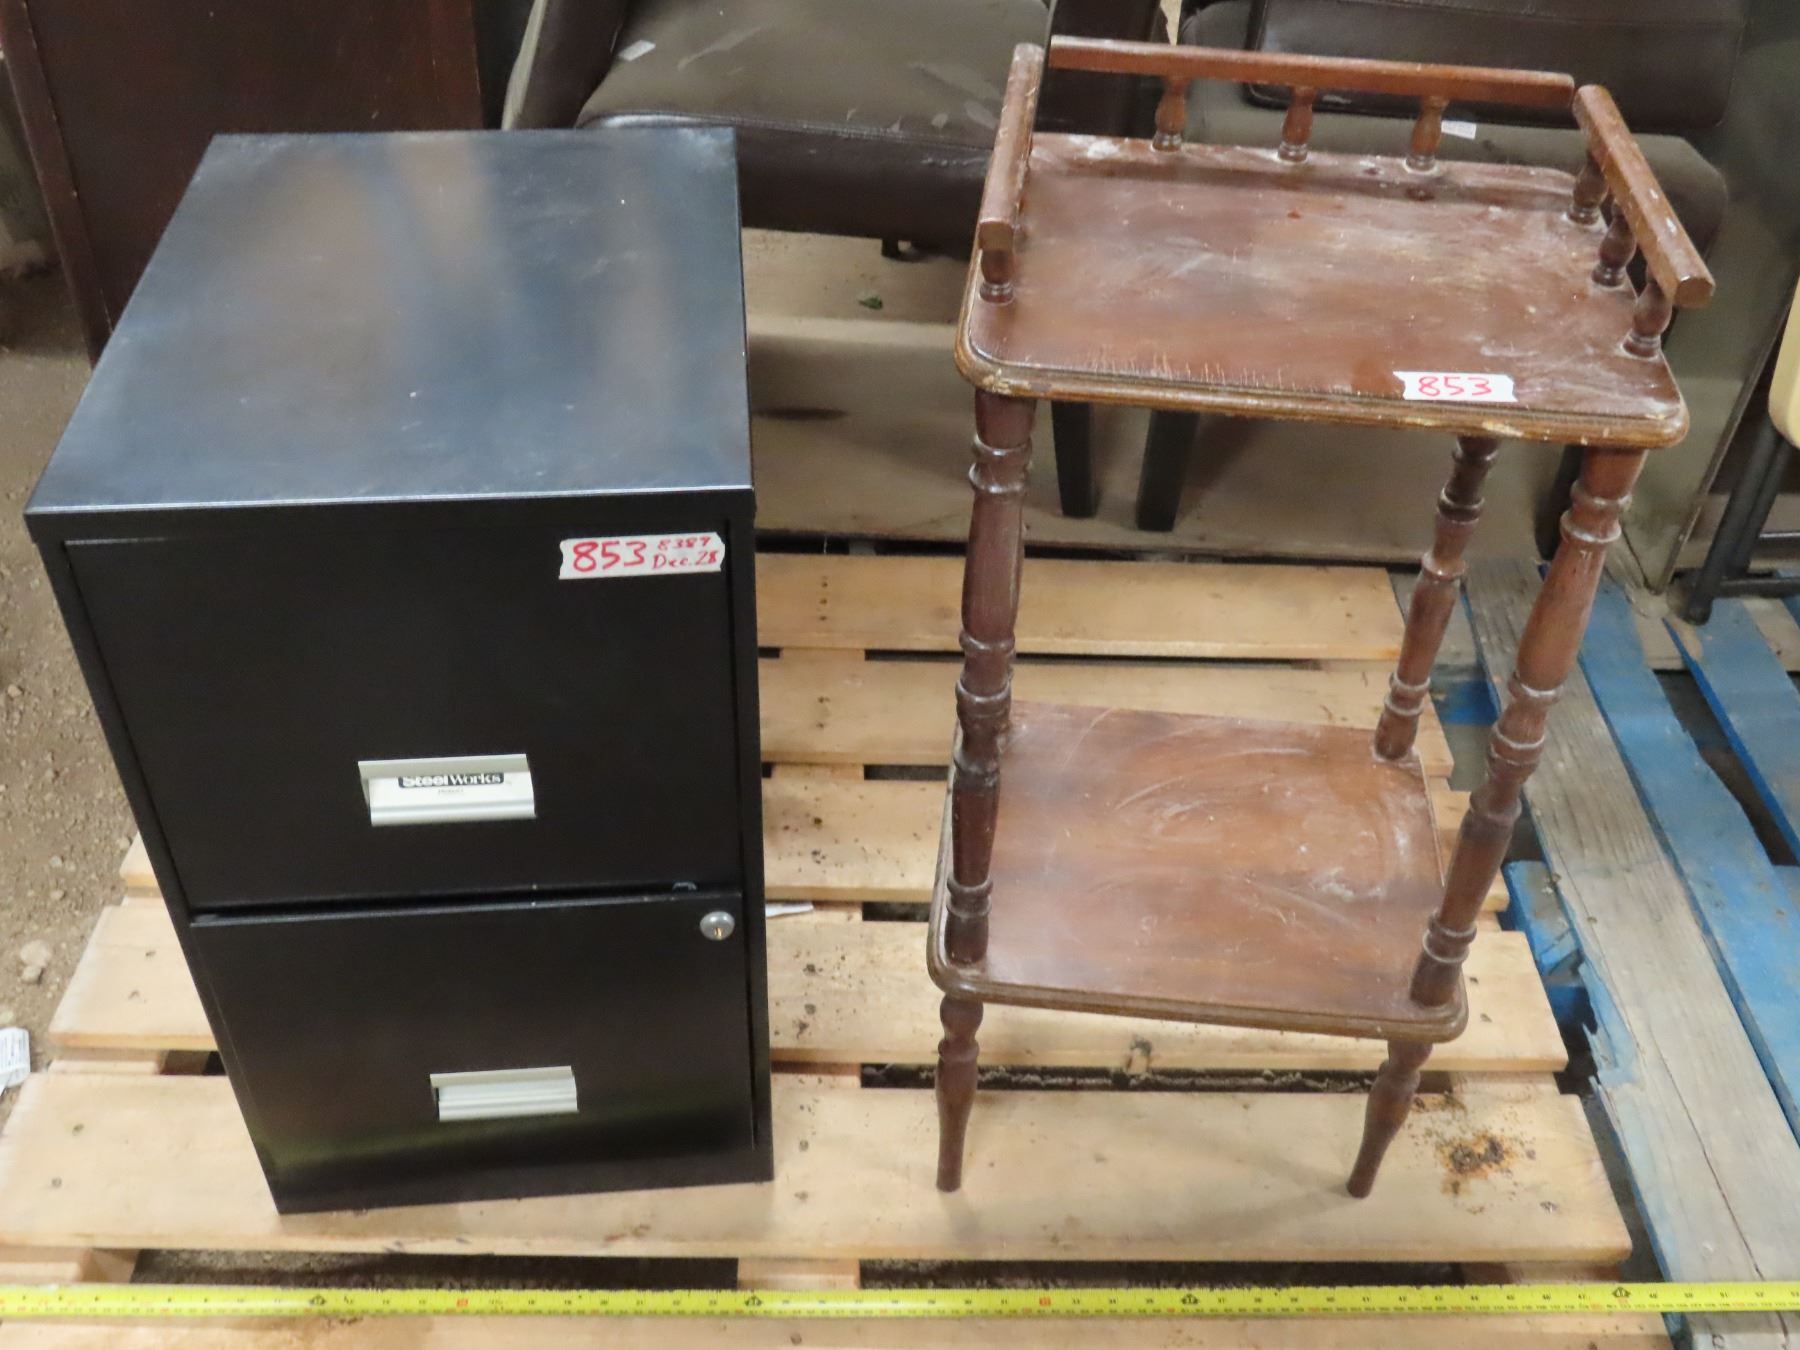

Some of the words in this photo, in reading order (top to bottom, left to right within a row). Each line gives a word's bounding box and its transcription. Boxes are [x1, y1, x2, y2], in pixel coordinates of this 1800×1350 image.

[1418, 376, 1492, 397] 853
[572, 540, 647, 572] 853
[402, 773, 501, 788] SteelWorks
